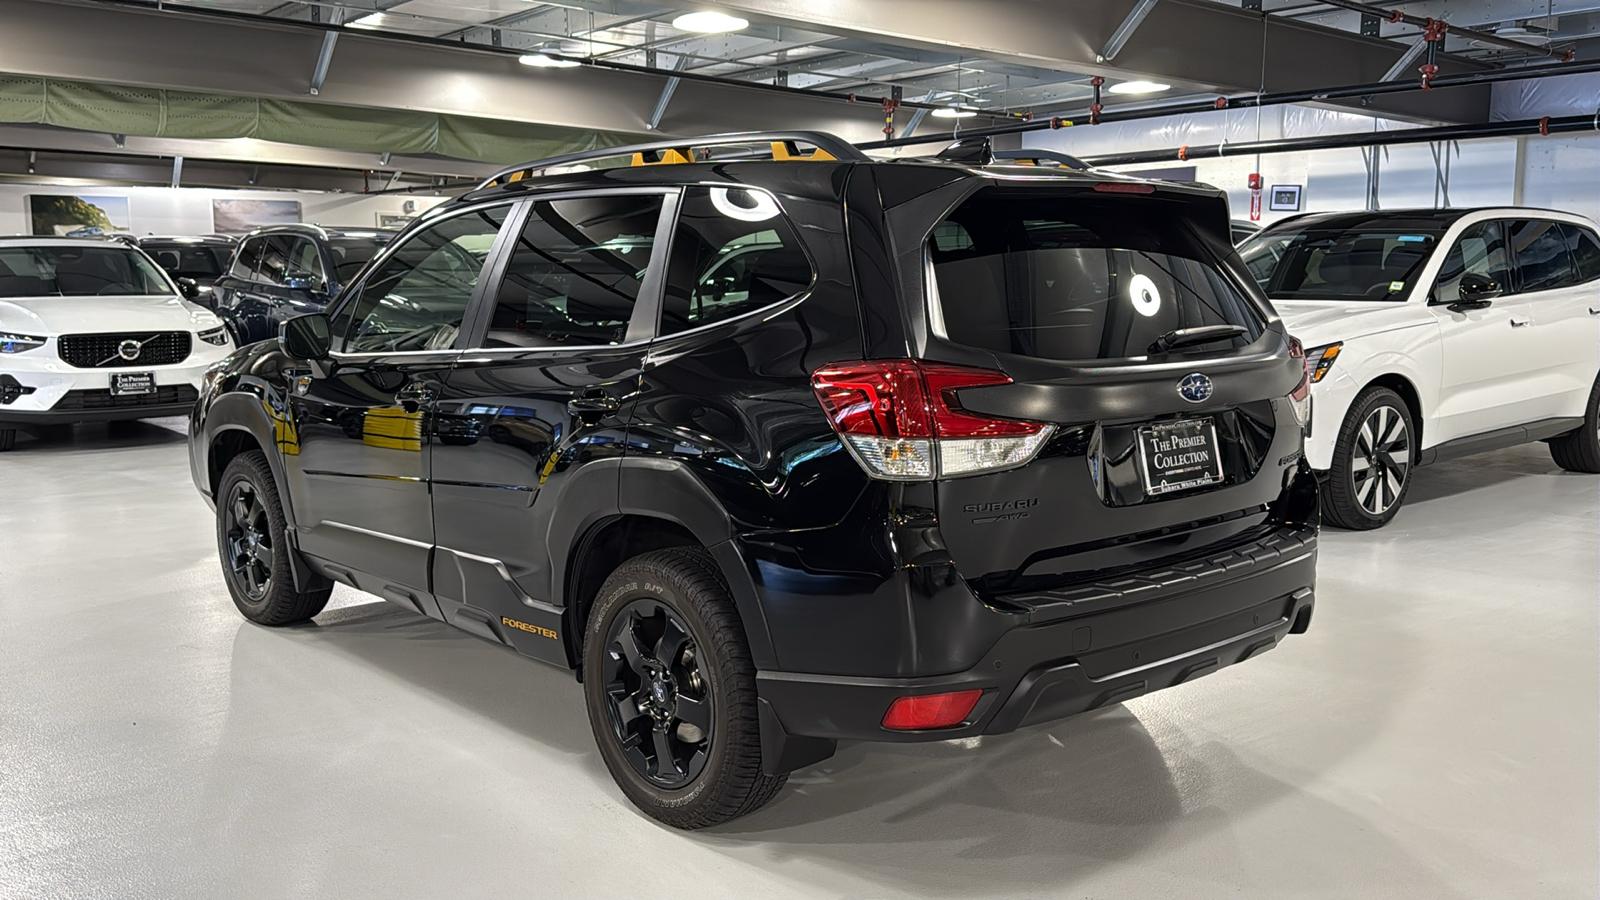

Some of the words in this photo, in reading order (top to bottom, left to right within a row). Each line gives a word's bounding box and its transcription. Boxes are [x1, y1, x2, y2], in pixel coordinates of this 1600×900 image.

[1150, 438, 1171, 453] THE
[1171, 435, 1206, 450] PREMIER
[1154, 451, 1209, 469] COLLECTION
[1161, 484, 1180, 493] Subaru
[1181, 481, 1196, 489] White
[1197, 478, 1213, 486] Plains
[963, 498, 1040, 513] SUBARU
[502, 616, 558, 640] FORESTER
